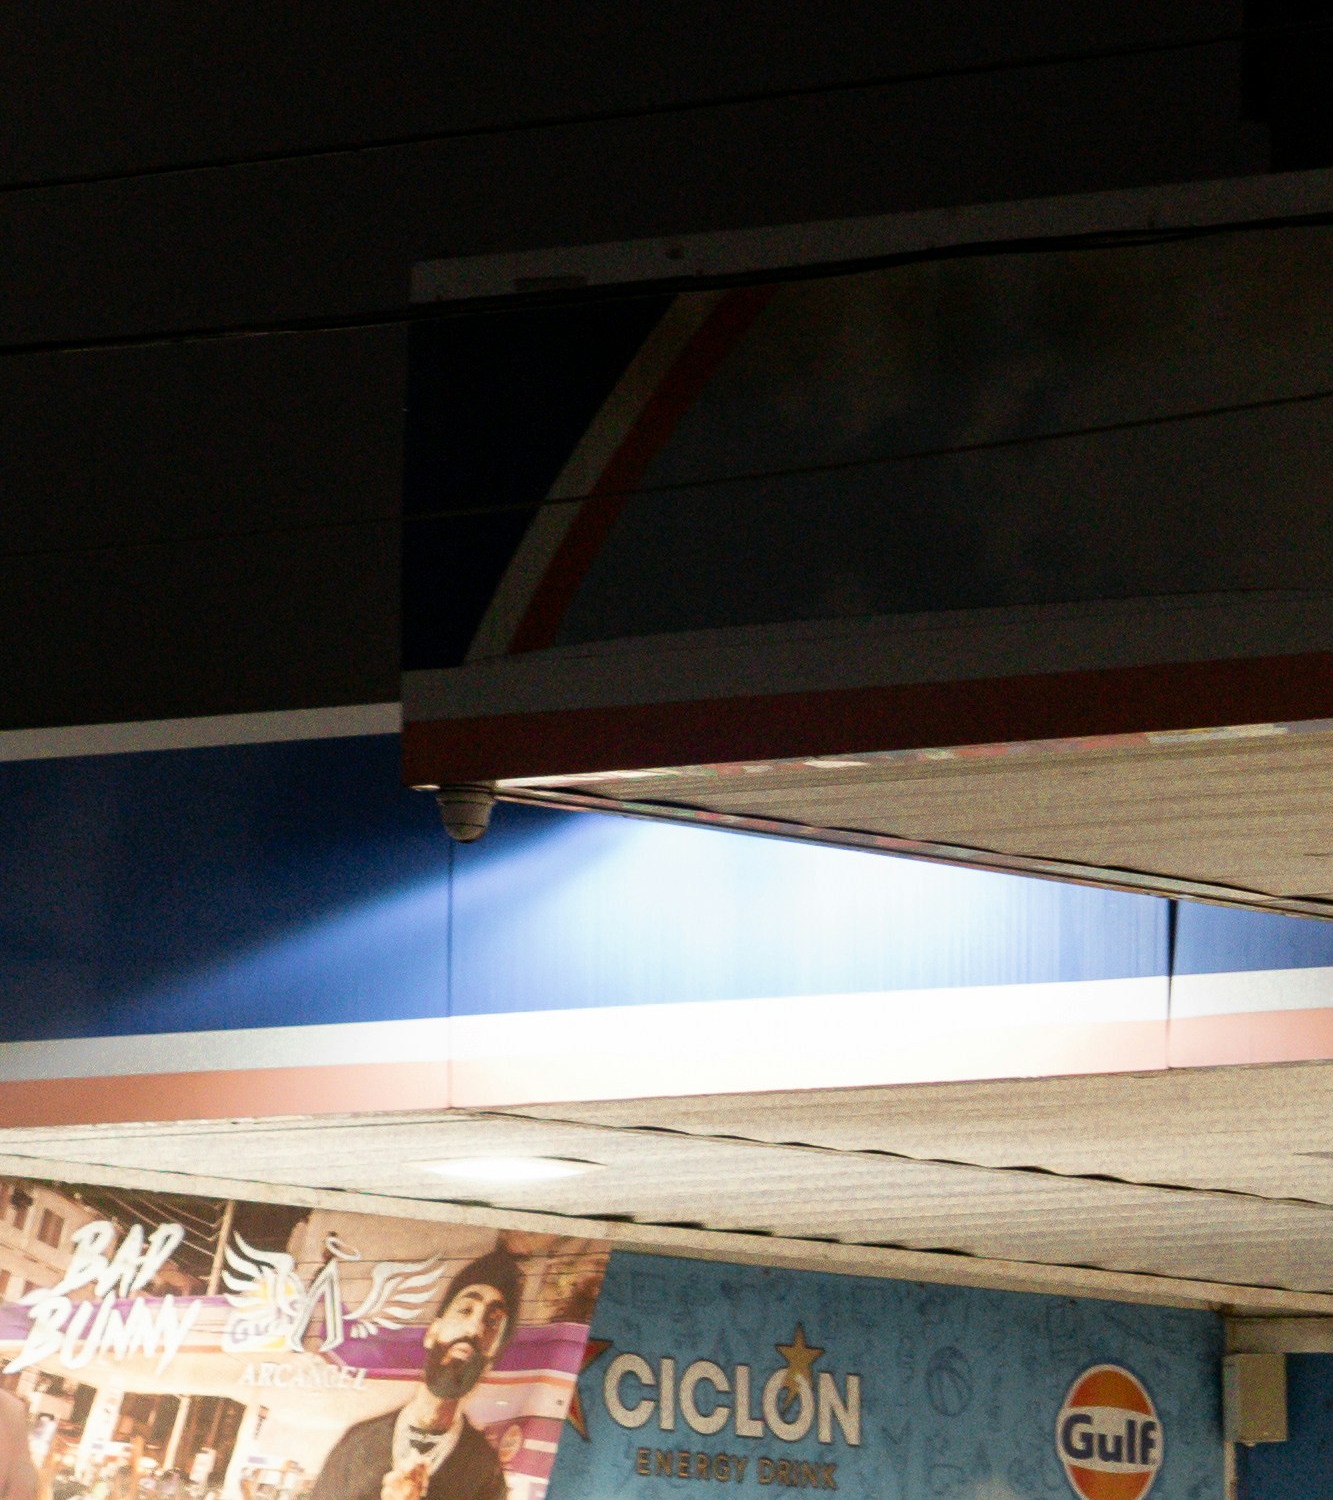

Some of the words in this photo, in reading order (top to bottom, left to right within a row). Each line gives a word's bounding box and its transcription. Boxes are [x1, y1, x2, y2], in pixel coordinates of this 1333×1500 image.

[57, 1220, 185, 1298] BAD
[1063, 1414, 1157, 1465] Gulf
[636, 1447, 747, 1483] ENERGY
[757, 1456, 839, 1490] DRINK
